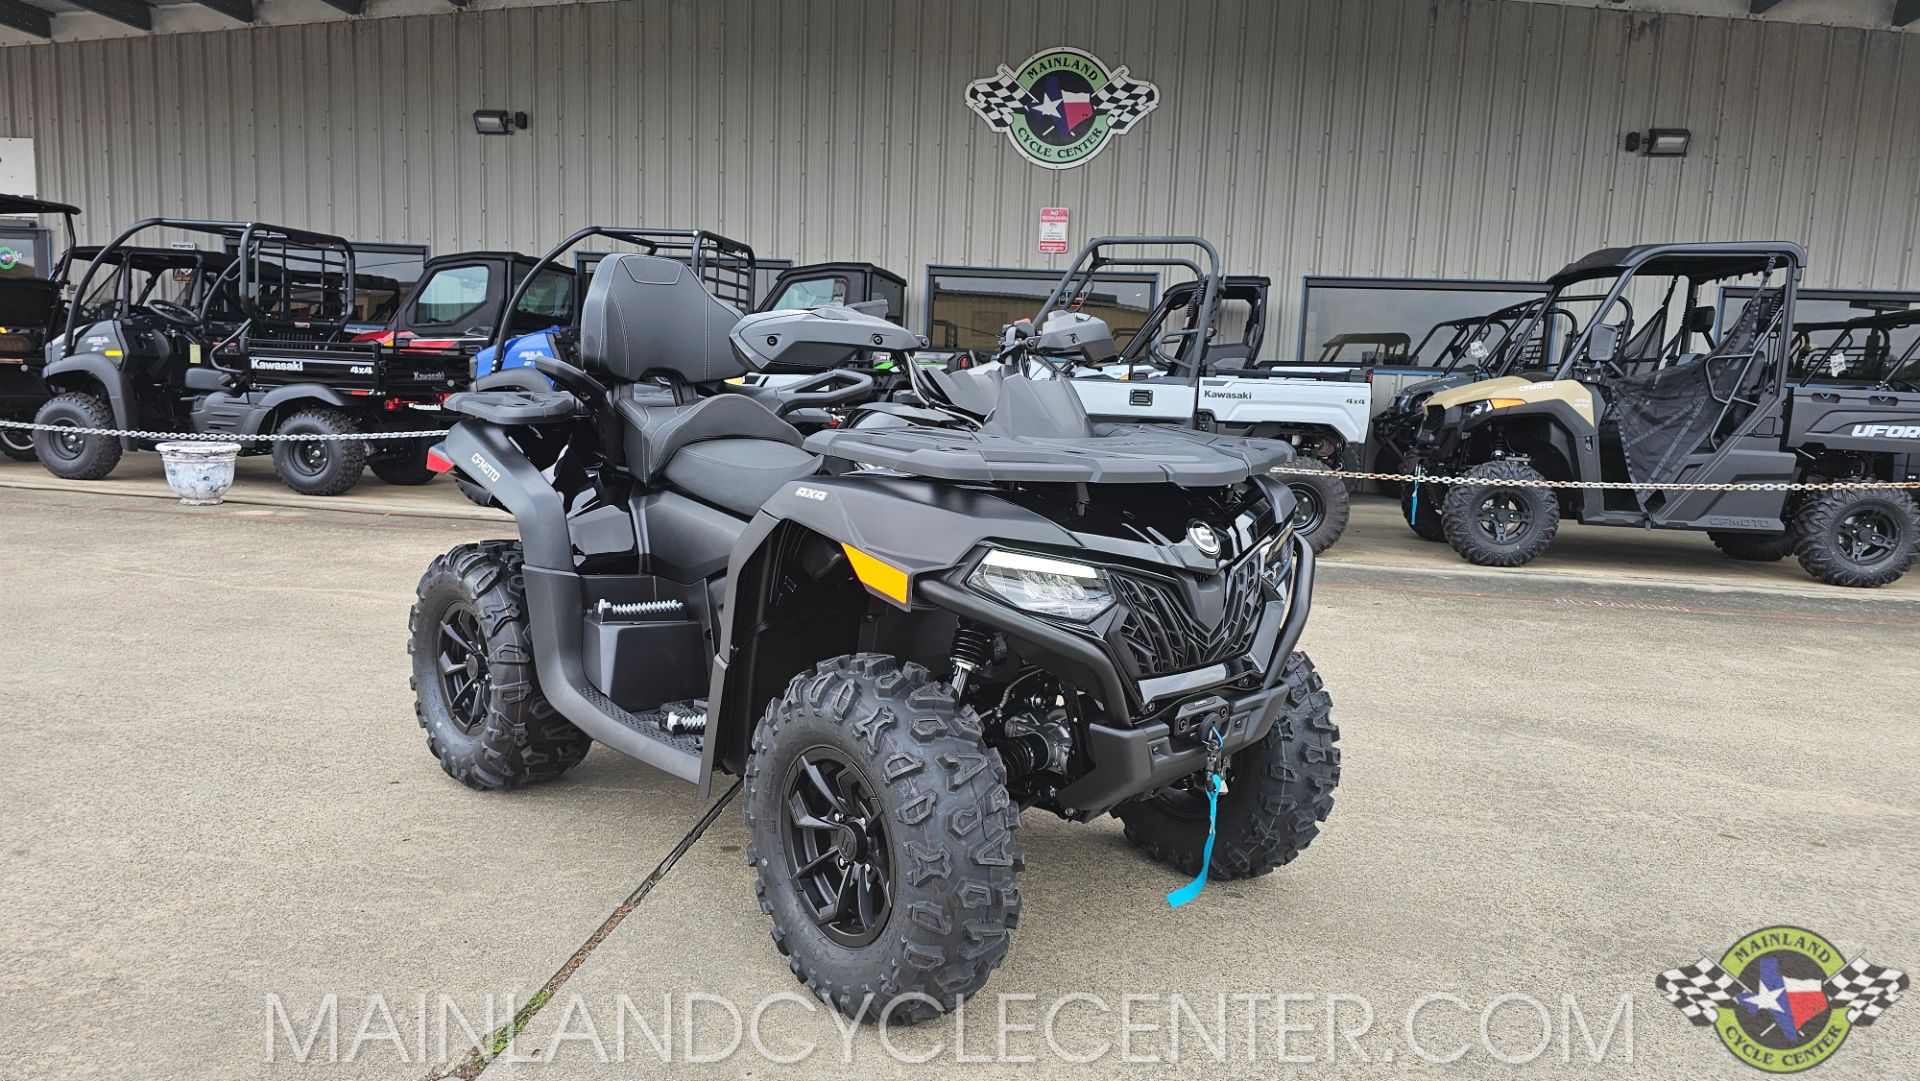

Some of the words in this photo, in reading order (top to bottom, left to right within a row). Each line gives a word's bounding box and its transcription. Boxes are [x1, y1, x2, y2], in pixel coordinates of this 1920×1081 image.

[1027, 57, 1099, 82] MAINLAND
[1018, 127, 1051, 158] CYCLE
[1057, 128, 1103, 159] CENTER
[251, 359, 303, 371] Kawasaki
[350, 366, 374, 375] 4x4
[413, 371, 445, 381] Kawasaki
[1204, 390, 1252, 400] Kawasaki
[408, 402, 441, 411] Kawasaki
[471, 452, 501, 482] CFMOTO
[1709, 517, 1772, 528] CFMOTO
